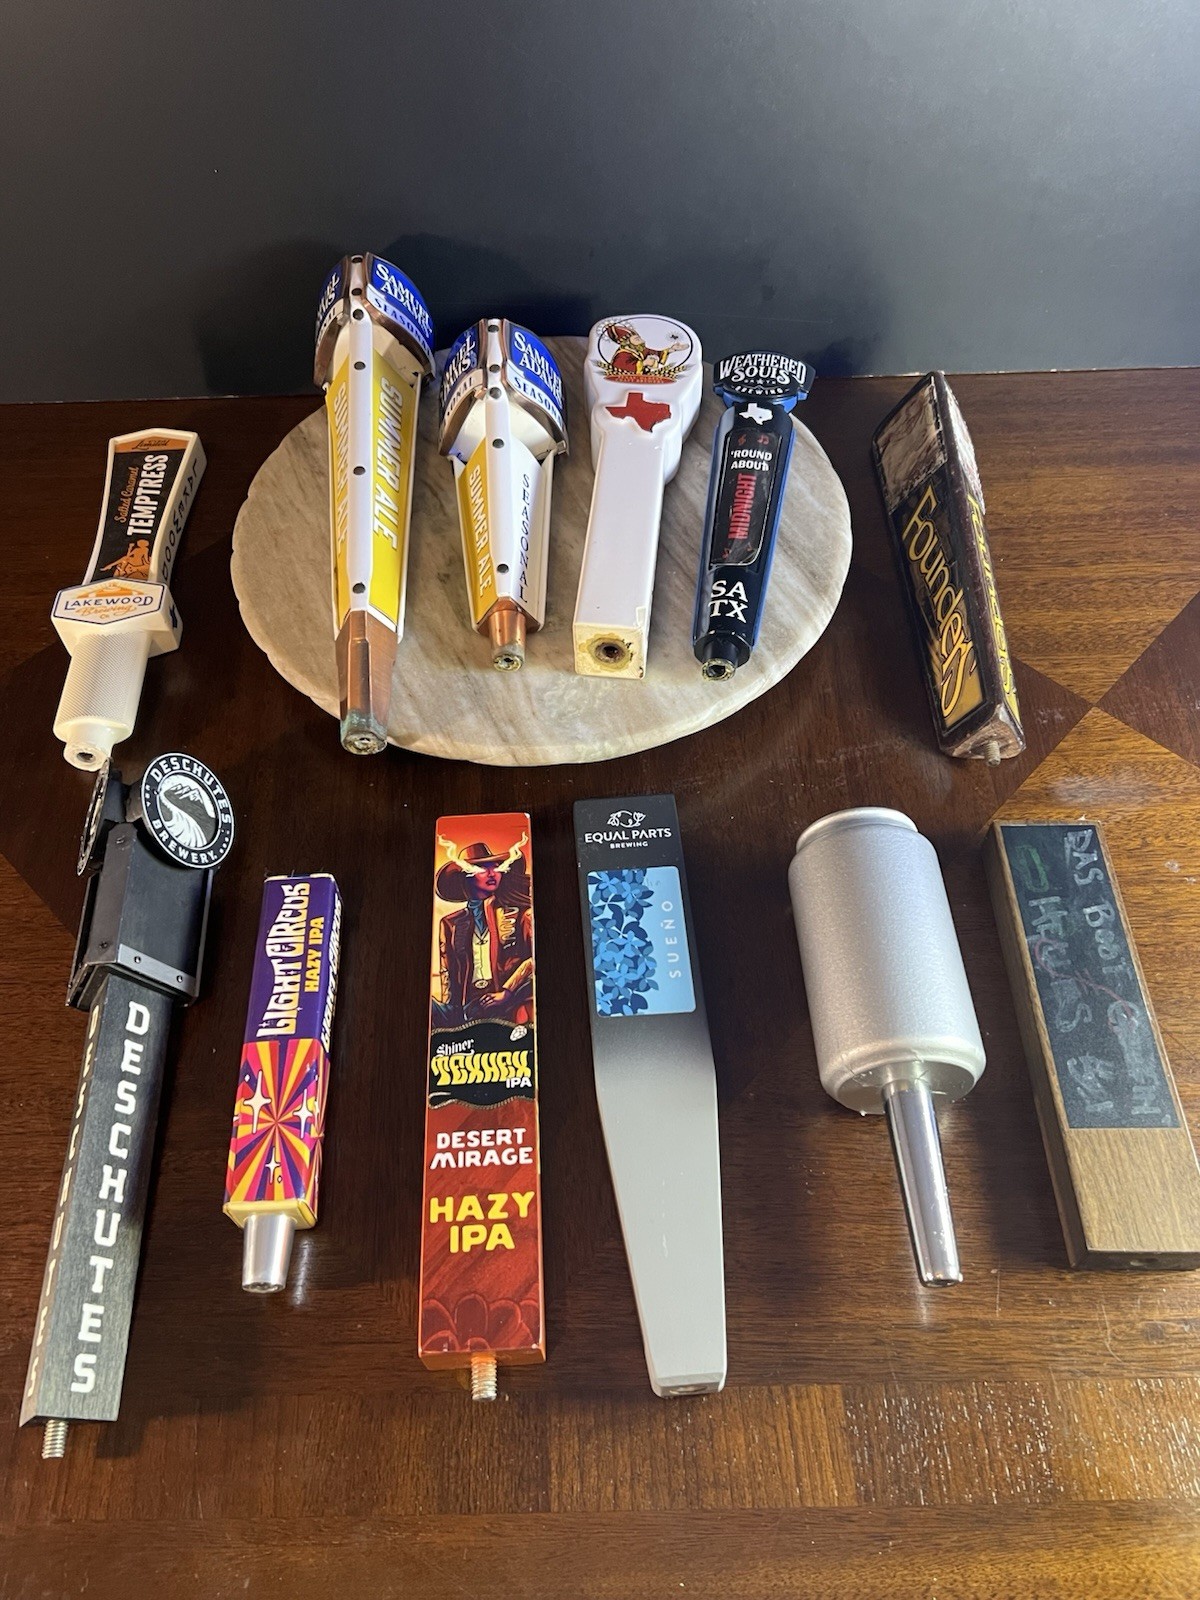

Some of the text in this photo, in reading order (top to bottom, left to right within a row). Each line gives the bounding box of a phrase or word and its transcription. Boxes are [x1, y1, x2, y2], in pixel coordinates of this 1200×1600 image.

[719, 353, 807, 386] WEATHERED
[374, 377, 403, 550] SUMMER ALE
[730, 461, 770, 471] ABOUT
[114, 466, 140, 523] Salted Caramel
[126, 454, 169, 536] TEMPTRESS
[728, 473, 757, 540] MIDNIGHT
[469, 464, 493, 598] SUMMER ALE
[518, 474, 531, 603] SEASONAL
[64, 595, 154, 611] LAKEWOOD
[711, 580, 748, 602] SA
[902, 484, 978, 718] Founders
[708, 600, 749, 623] TX
[151, 757, 231, 824] DESCHUTES
[584, 827, 672, 843] EQUAL PARTS
[610, 840, 649, 849] BREWING
[1064, 828, 1105, 887] DAS
[256, 882, 311, 1038] LIGHT CIRCUS
[304, 916, 325, 993] HAZY IPA
[436, 1037, 475, 1057] Shiner
[505, 1077, 533, 1089] IPA
[436, 1127, 527, 1150] DESERT
[430, 1147, 534, 1170] MIRAGE
[70, 1001, 151, 1394] DESCHUTES
[429, 1191, 535, 1224] HAZY
[449, 1223, 516, 1254] IPA
